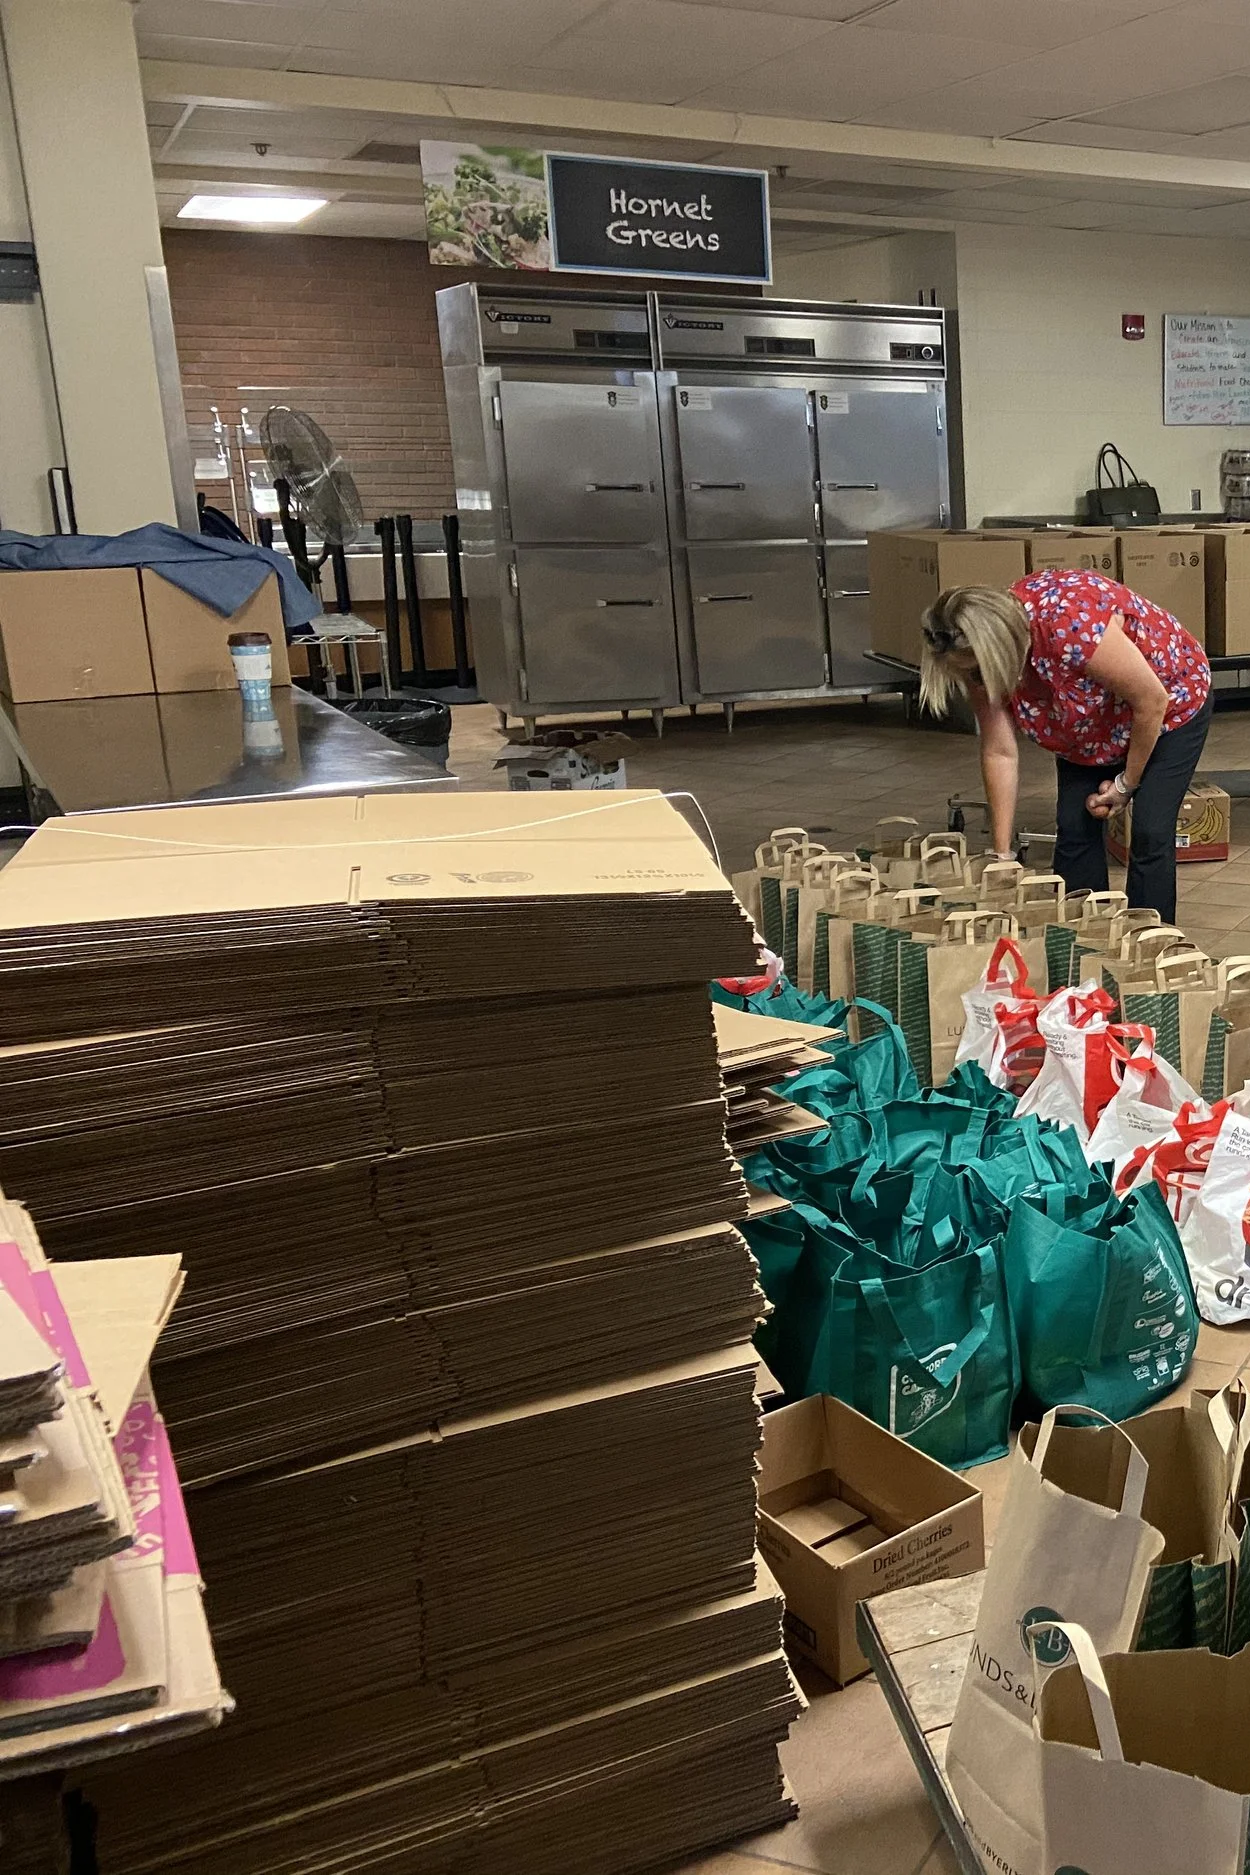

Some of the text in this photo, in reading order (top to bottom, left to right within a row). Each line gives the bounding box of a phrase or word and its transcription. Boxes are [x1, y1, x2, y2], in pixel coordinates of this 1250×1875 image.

[609, 188, 712, 221] Hornet
[605, 220, 720, 251] Greens
[1230, 1133, 1245, 1144] Run
[873, 1524, 953, 1575] Dried Cherries
